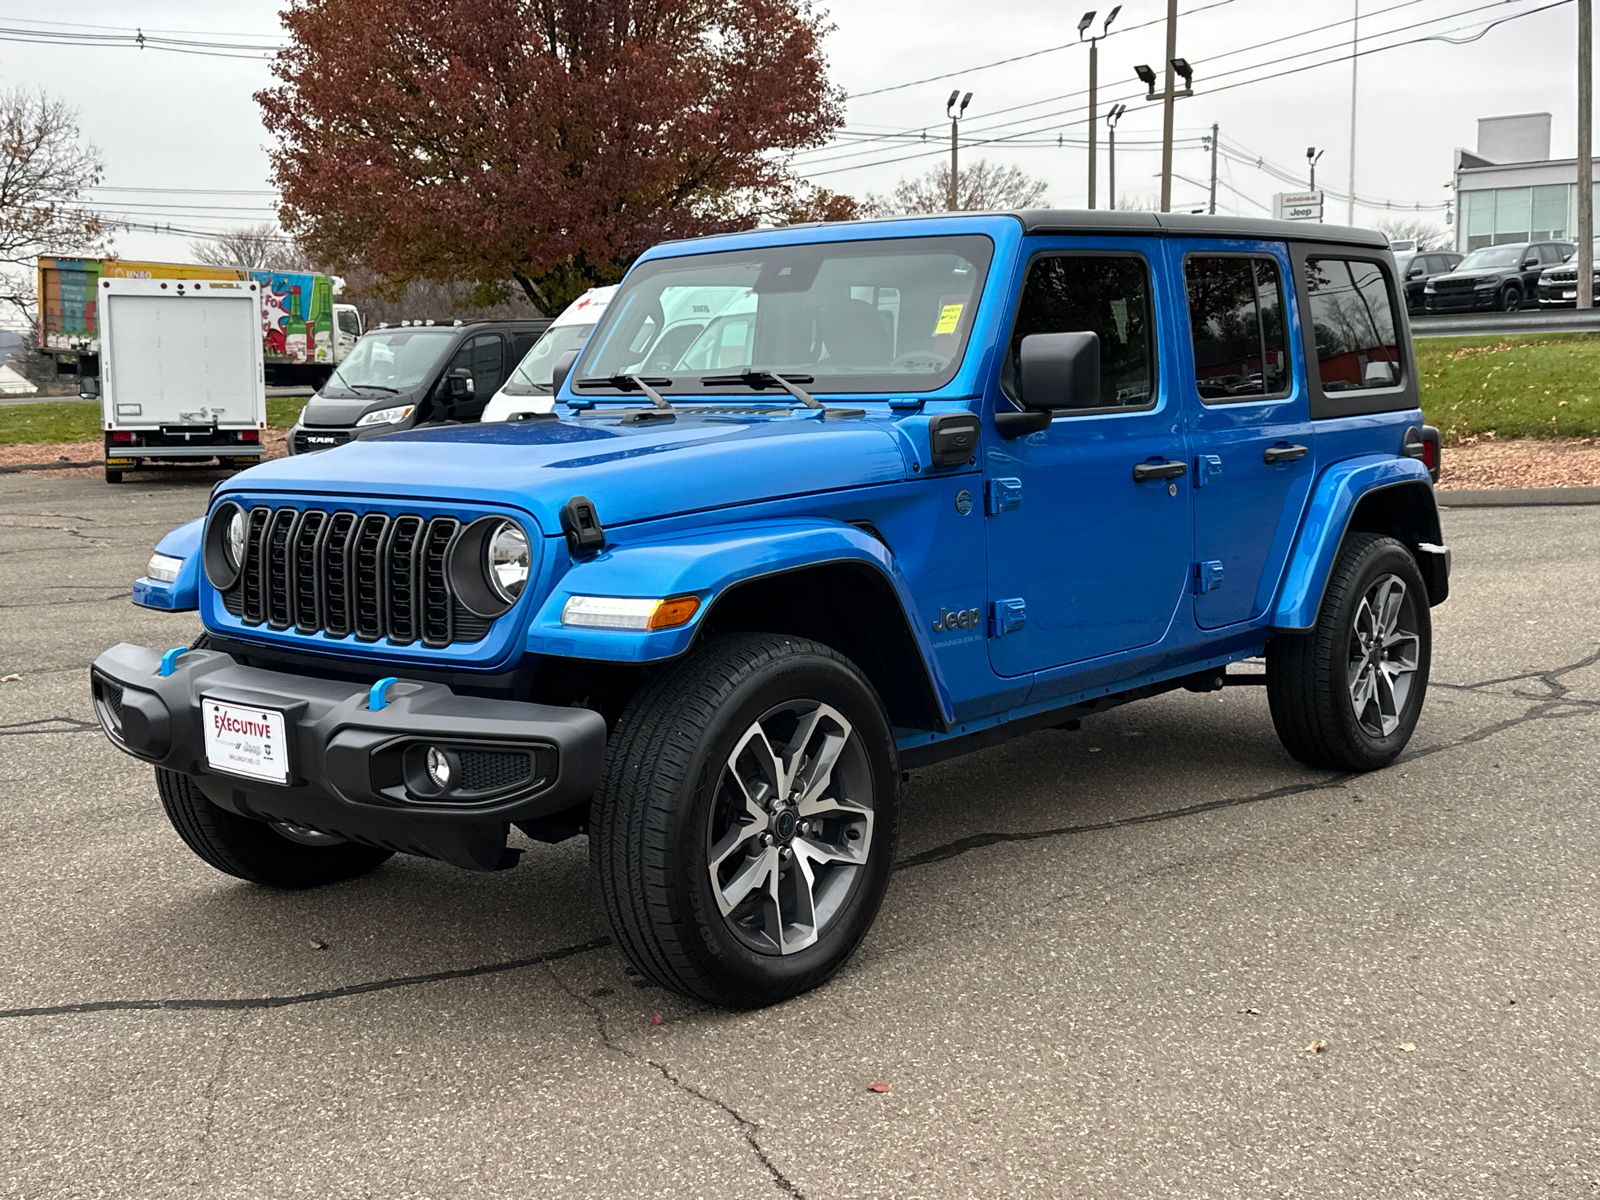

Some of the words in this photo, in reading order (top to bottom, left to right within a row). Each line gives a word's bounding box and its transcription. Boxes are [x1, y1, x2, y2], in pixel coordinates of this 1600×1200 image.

[1290, 208, 1312, 217] Jeep
[307, 436, 335, 444] RAM
[932, 607, 981, 633] Jeep
[933, 635, 974, 649] WRANGLER
[214, 711, 271, 739] EXECUTIVE
[242, 742, 261, 756] Jeep
